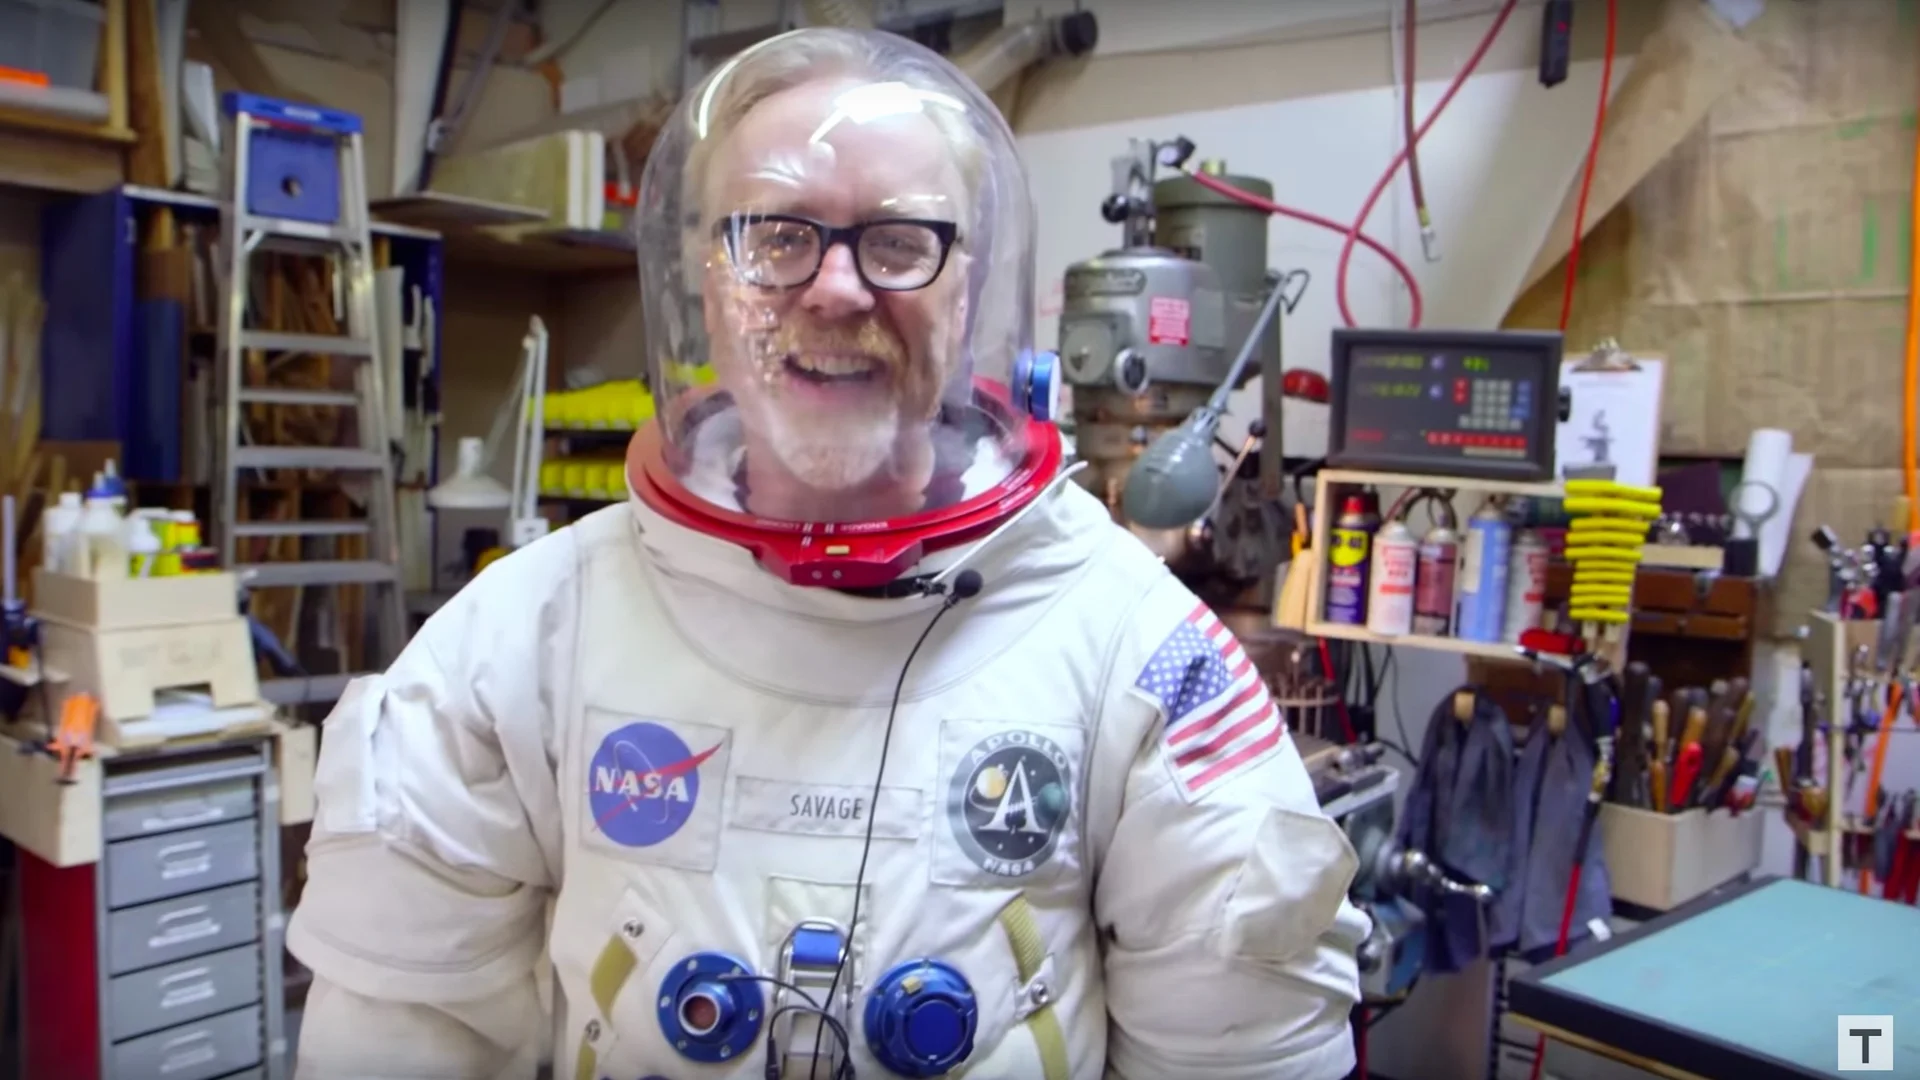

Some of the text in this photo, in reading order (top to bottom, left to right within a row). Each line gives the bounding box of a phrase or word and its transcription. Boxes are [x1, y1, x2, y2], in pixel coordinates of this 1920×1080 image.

[971, 730, 1068, 770] APOLLO
[595, 765, 690, 803] NASA
[790, 794, 864, 820] SAVAGE
[983, 857, 1036, 876] NASA
